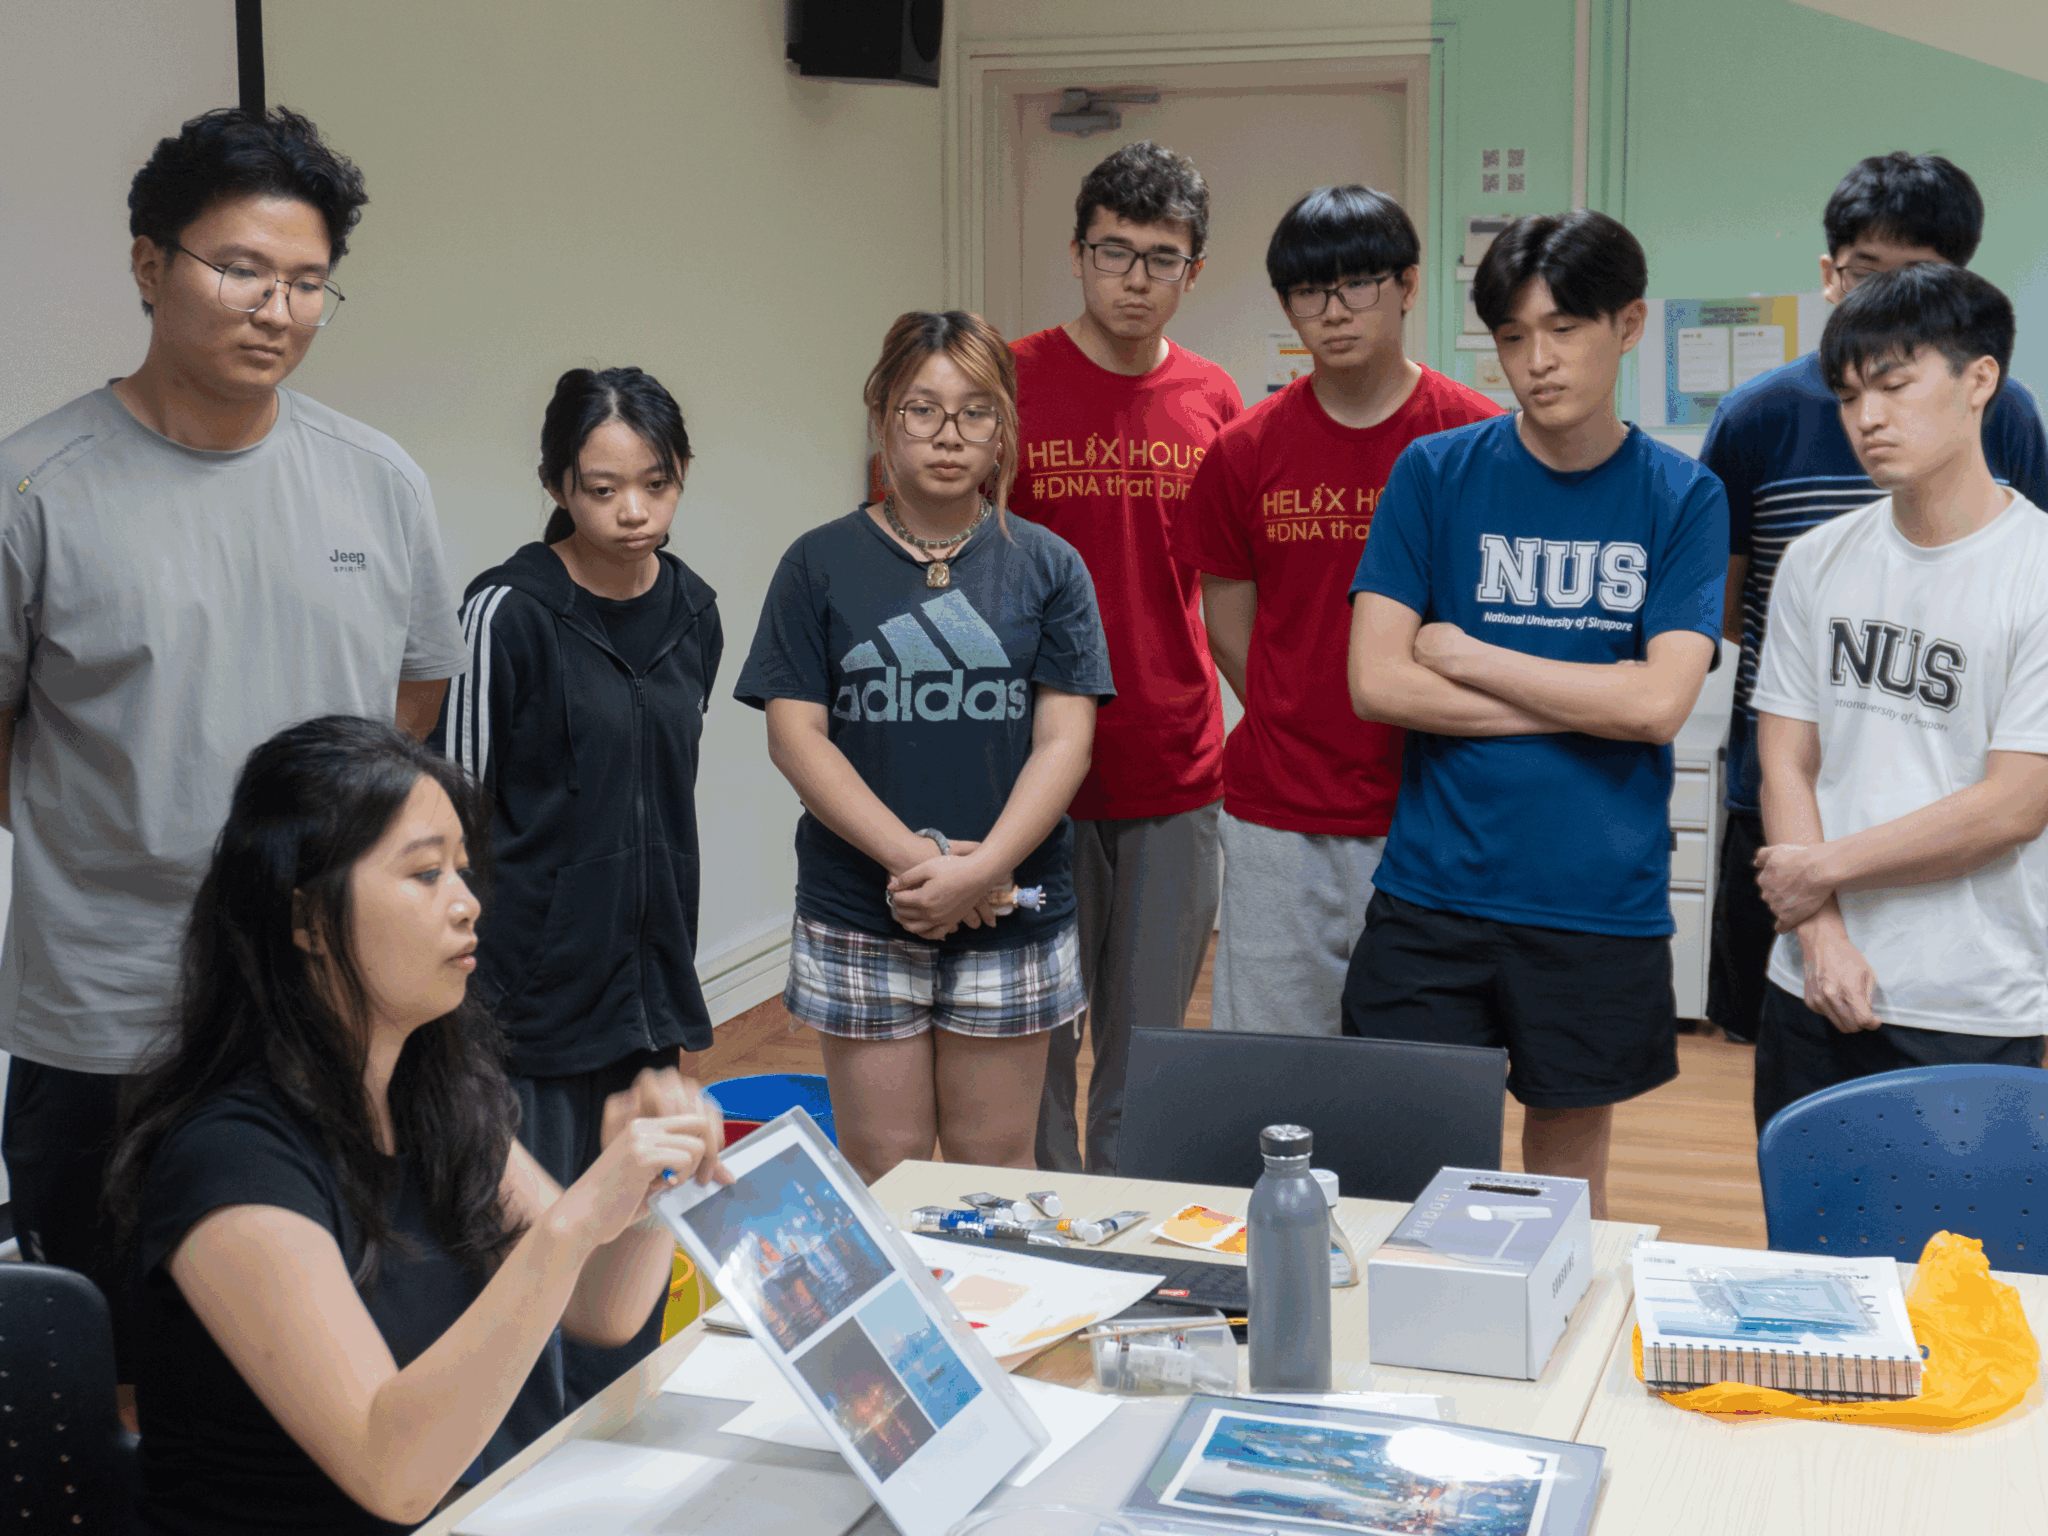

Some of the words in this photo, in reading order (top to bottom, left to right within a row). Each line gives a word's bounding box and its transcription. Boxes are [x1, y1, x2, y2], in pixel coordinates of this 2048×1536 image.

[1129, 438, 1206, 470] HOUS
[1032, 475, 1101, 500] #DNA
[1106, 474, 1153, 497] that
[1266, 520, 1324, 542] #DNA
[1330, 520, 1370, 540] tha
[329, 548, 366, 566] Jeep
[1476, 533, 1648, 613] NUS
[1483, 611, 1525, 625] National
[1526, 614, 1574, 630] University
[1575, 616, 1588, 630] of
[1828, 617, 1968, 714] NUS
[832, 666, 1027, 722] adidas
[1901, 712, 1914, 725] of
